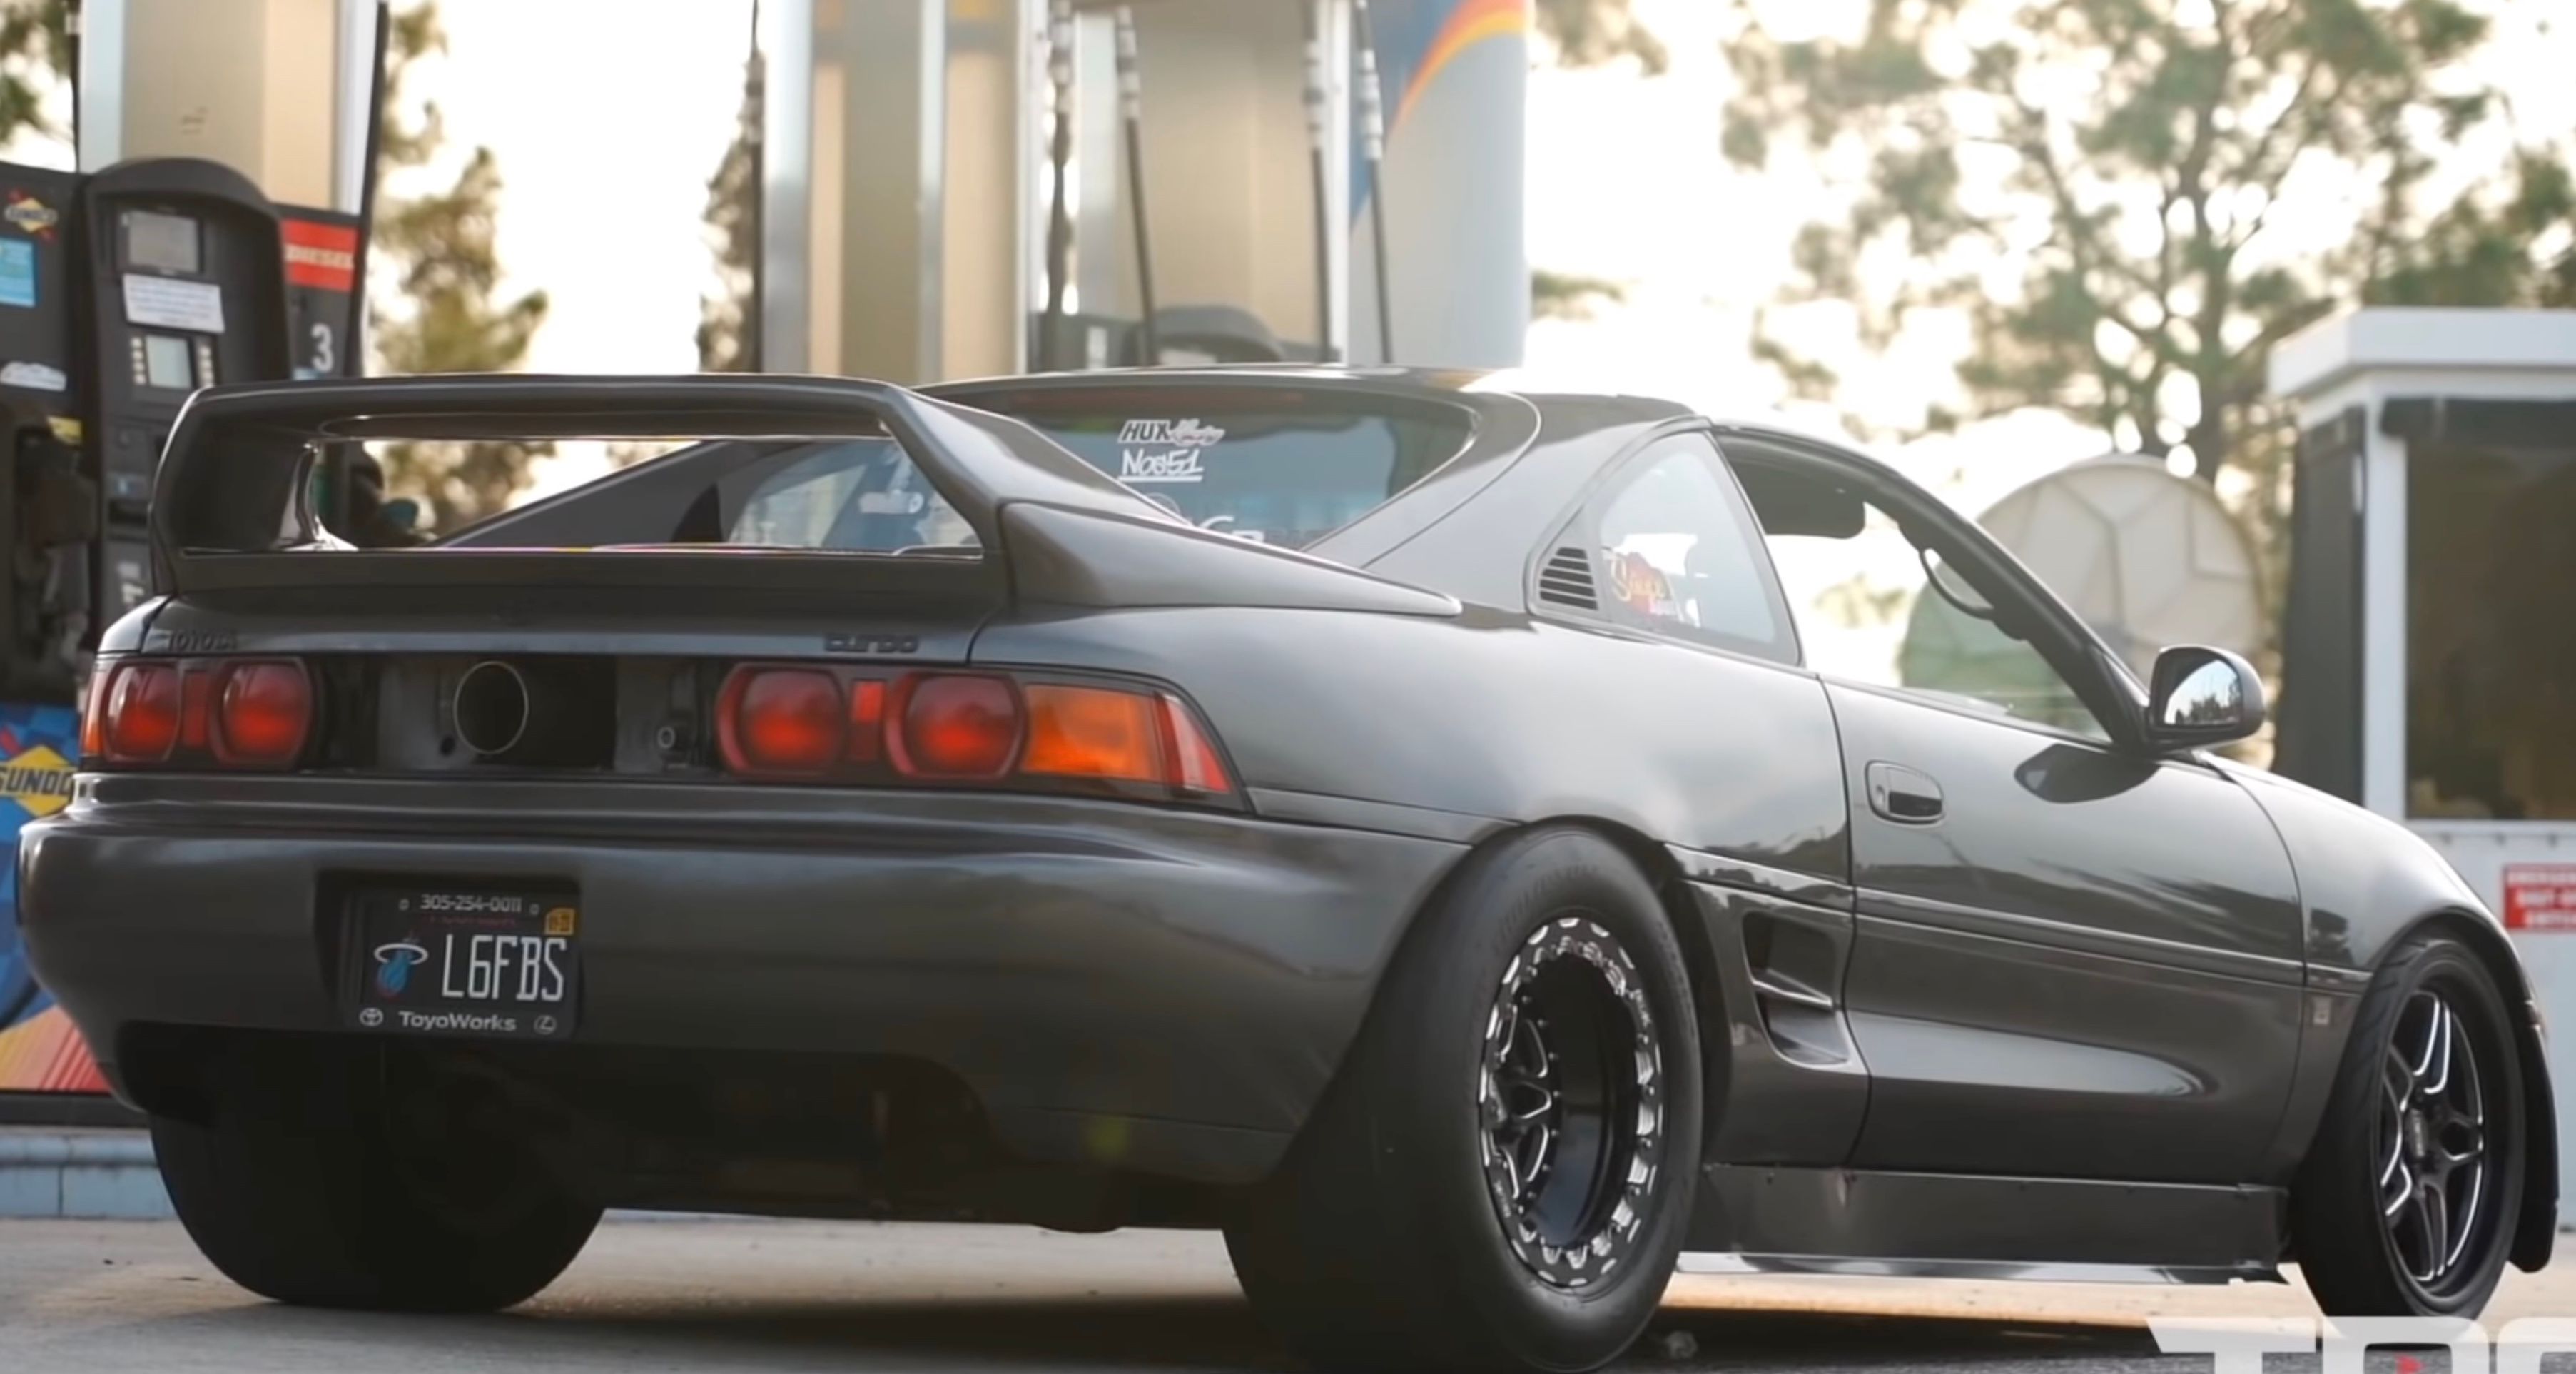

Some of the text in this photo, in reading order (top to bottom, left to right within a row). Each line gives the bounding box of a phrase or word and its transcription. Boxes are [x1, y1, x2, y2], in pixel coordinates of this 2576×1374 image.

[311, 323, 333, 372] 3
[1119, 420, 1171, 443] HUX
[420, 894, 522, 912] 305-254-0011
[442, 934, 567, 1001] L6FBS
[398, 1010, 517, 1031] ToyoWorks
